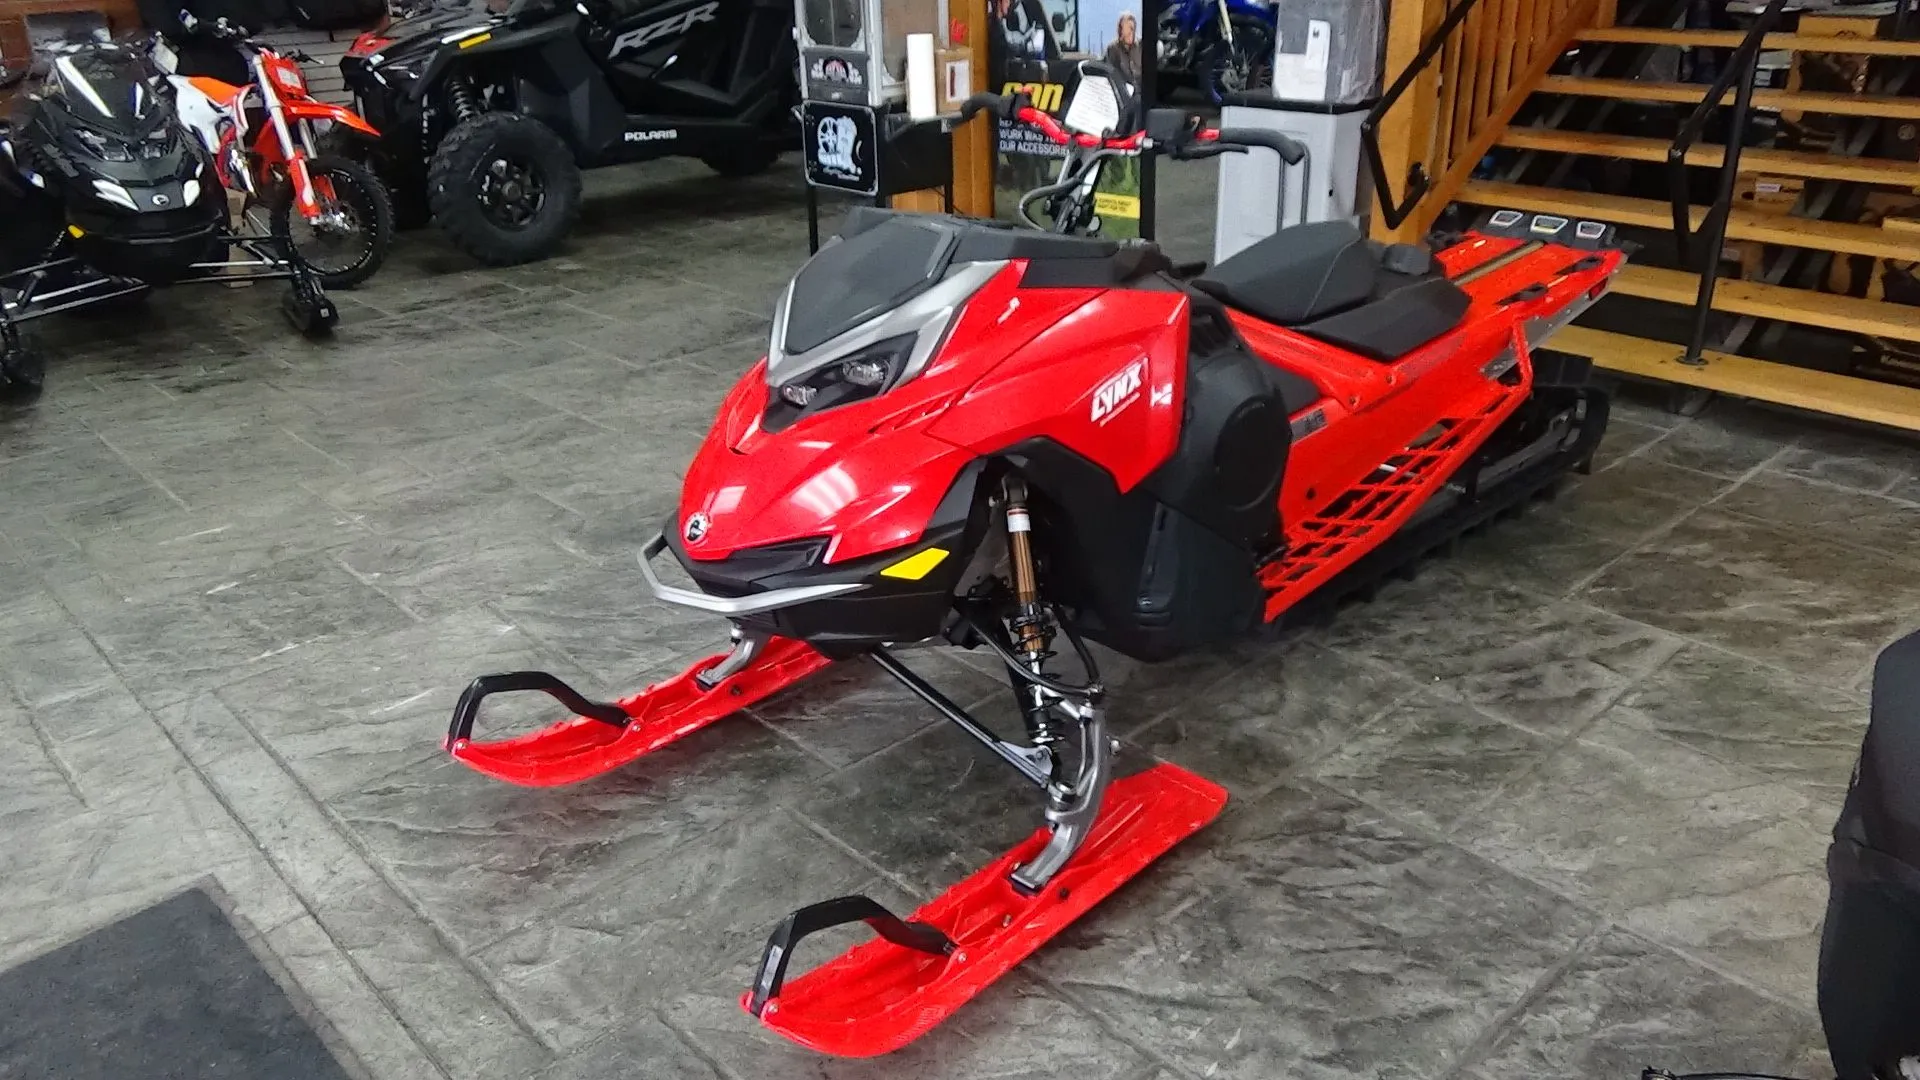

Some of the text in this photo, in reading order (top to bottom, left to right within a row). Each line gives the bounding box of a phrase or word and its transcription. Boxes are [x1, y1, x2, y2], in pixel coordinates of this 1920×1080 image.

[608, 1, 720, 59] RZR
[624, 129, 678, 141] POLARIS
[1091, 362, 1142, 422] LYNX
